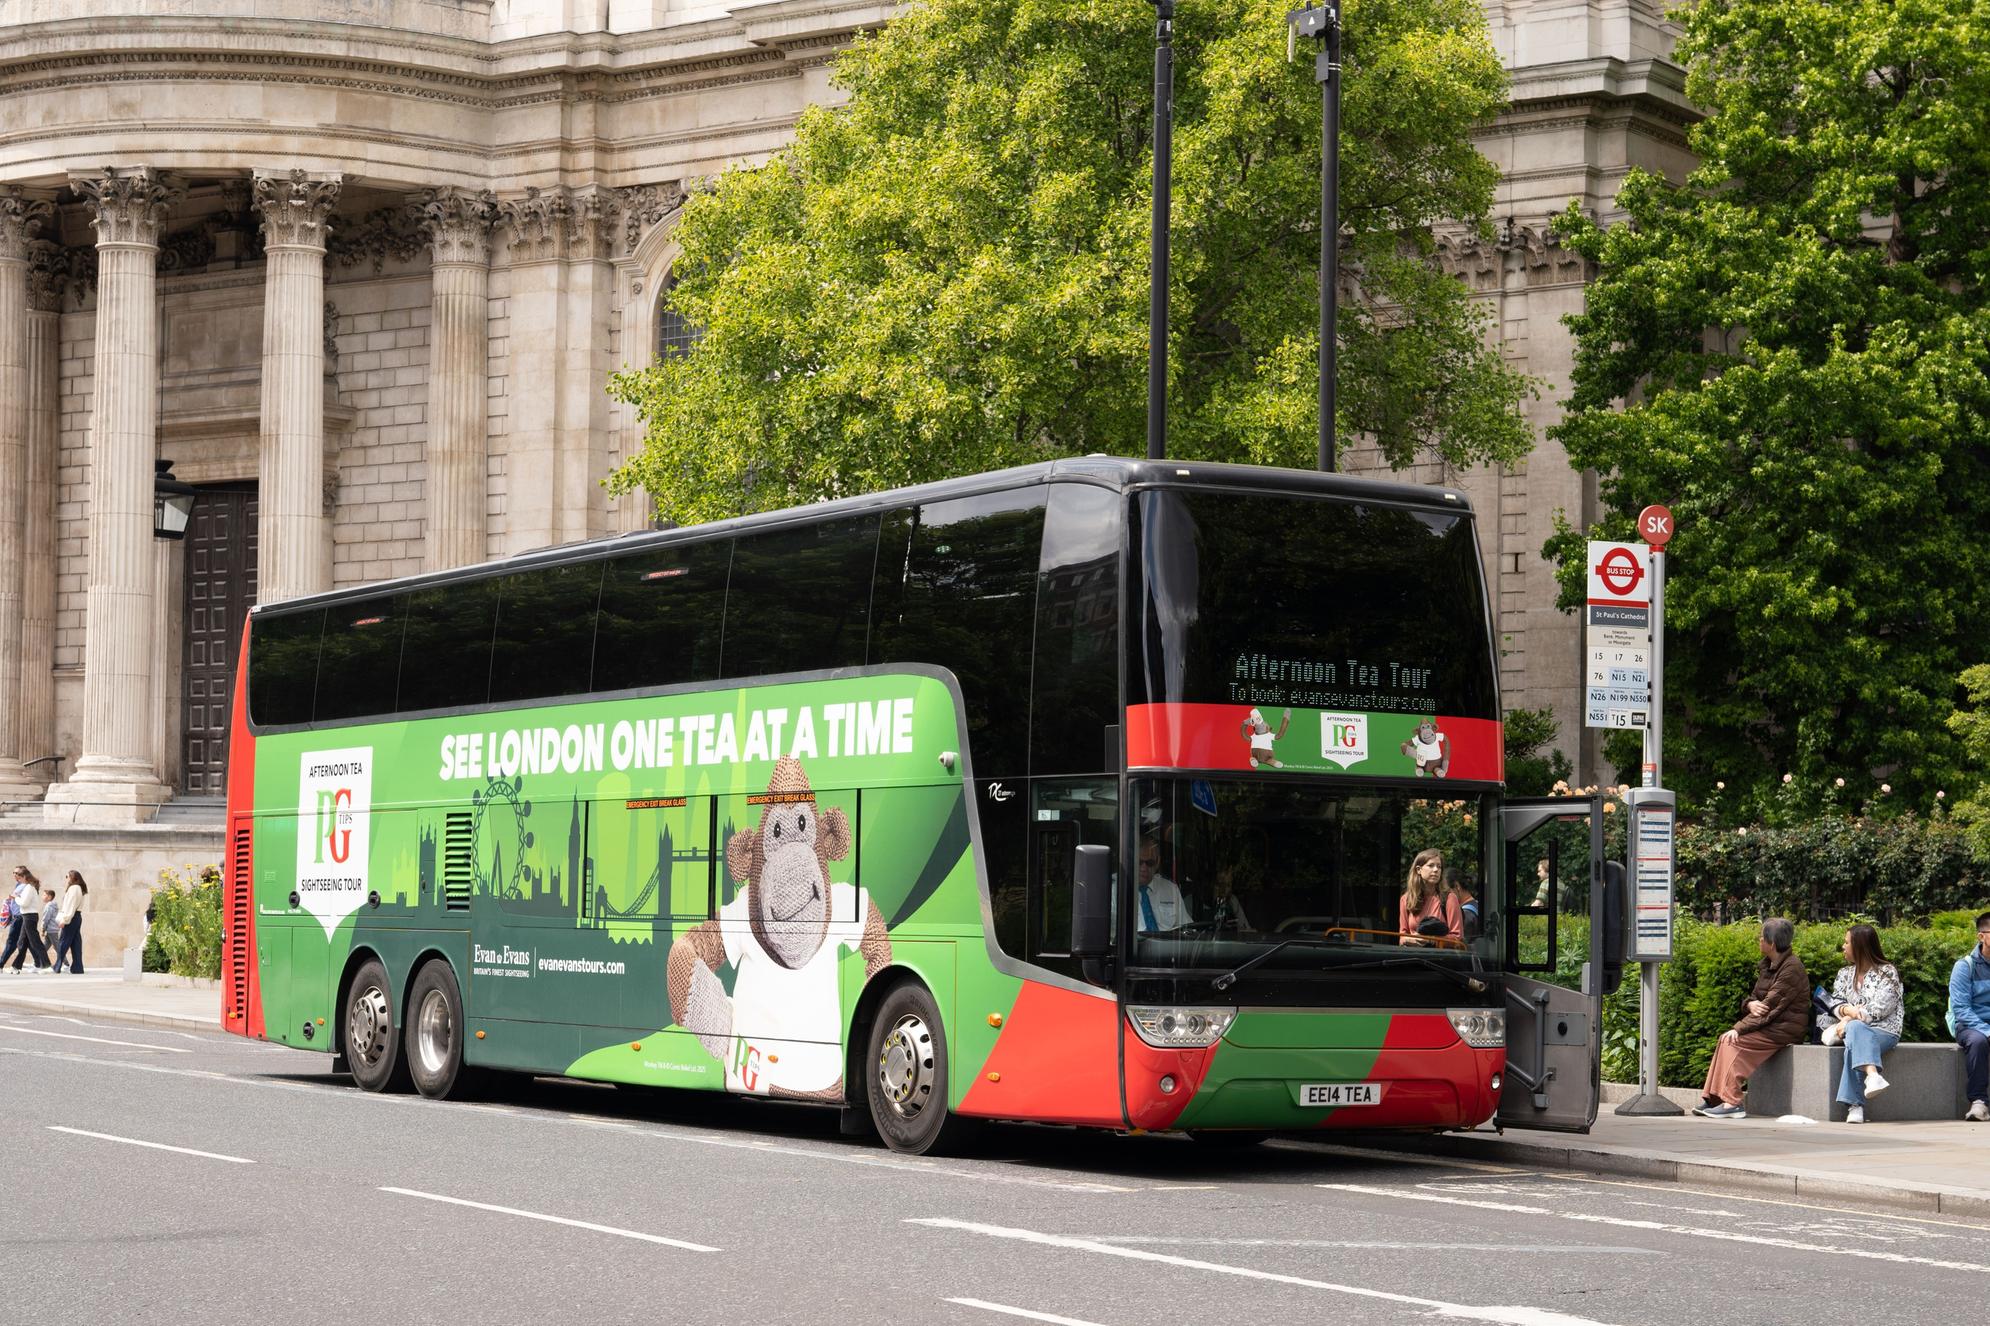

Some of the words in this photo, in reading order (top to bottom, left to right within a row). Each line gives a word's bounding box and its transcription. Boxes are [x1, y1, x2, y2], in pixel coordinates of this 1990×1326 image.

[1647, 516, 1668, 533] SK
[1619, 568, 1635, 576] STOP
[1236, 653, 1336, 683] Afternoon
[1347, 660, 1379, 686] Tea
[1390, 662, 1431, 688] Tour
[1594, 672, 1603, 680] 76
[1229, 683, 1246, 701] To
[1251, 684, 1285, 703] book:
[1290, 689, 1436, 711] evansevanstours.com
[1591, 693, 1606, 701] N26
[1610, 694, 1628, 702] N199
[1589, 713, 1607, 721] N551
[439, 733, 483, 781] SEE
[487, 723, 604, 777] LONDON
[611, 717, 674, 772] ONE
[679, 712, 739, 766] TEA
[743, 708, 788, 763] AT
[788, 706, 818, 760] A
[823, 698, 915, 757] TIME
[1333, 725, 1356, 747] PG
[309, 763, 349, 778] AFTERNOON
[350, 762, 363, 776] TEA
[626, 800, 650, 808] EMERGENCY
[650, 800, 658, 808] EXIT
[659, 799, 672, 807] BREAK
[673, 798, 686, 806] GLASS
[747, 795, 774, 804] EMERGENCY
[774, 794, 783, 802] EXIT
[784, 793, 800, 802] BREAK
[800, 793, 815, 801] GLASS
[314, 788, 352, 863] PG
[339, 814, 353, 824] TIPS
[301, 878, 343, 891] SIGHTSEEING
[344, 878, 362, 891] TOUR
[474, 944, 496, 963] Evan
[503, 945, 530, 965] Evans
[505, 969, 530, 978] SIGHTSEEING
[538, 957, 625, 975] evanevanstours.com
[733, 1032, 760, 1091] PG
[1309, 1086, 1340, 1103] EE14
[1345, 1086, 1371, 1102] TEA
